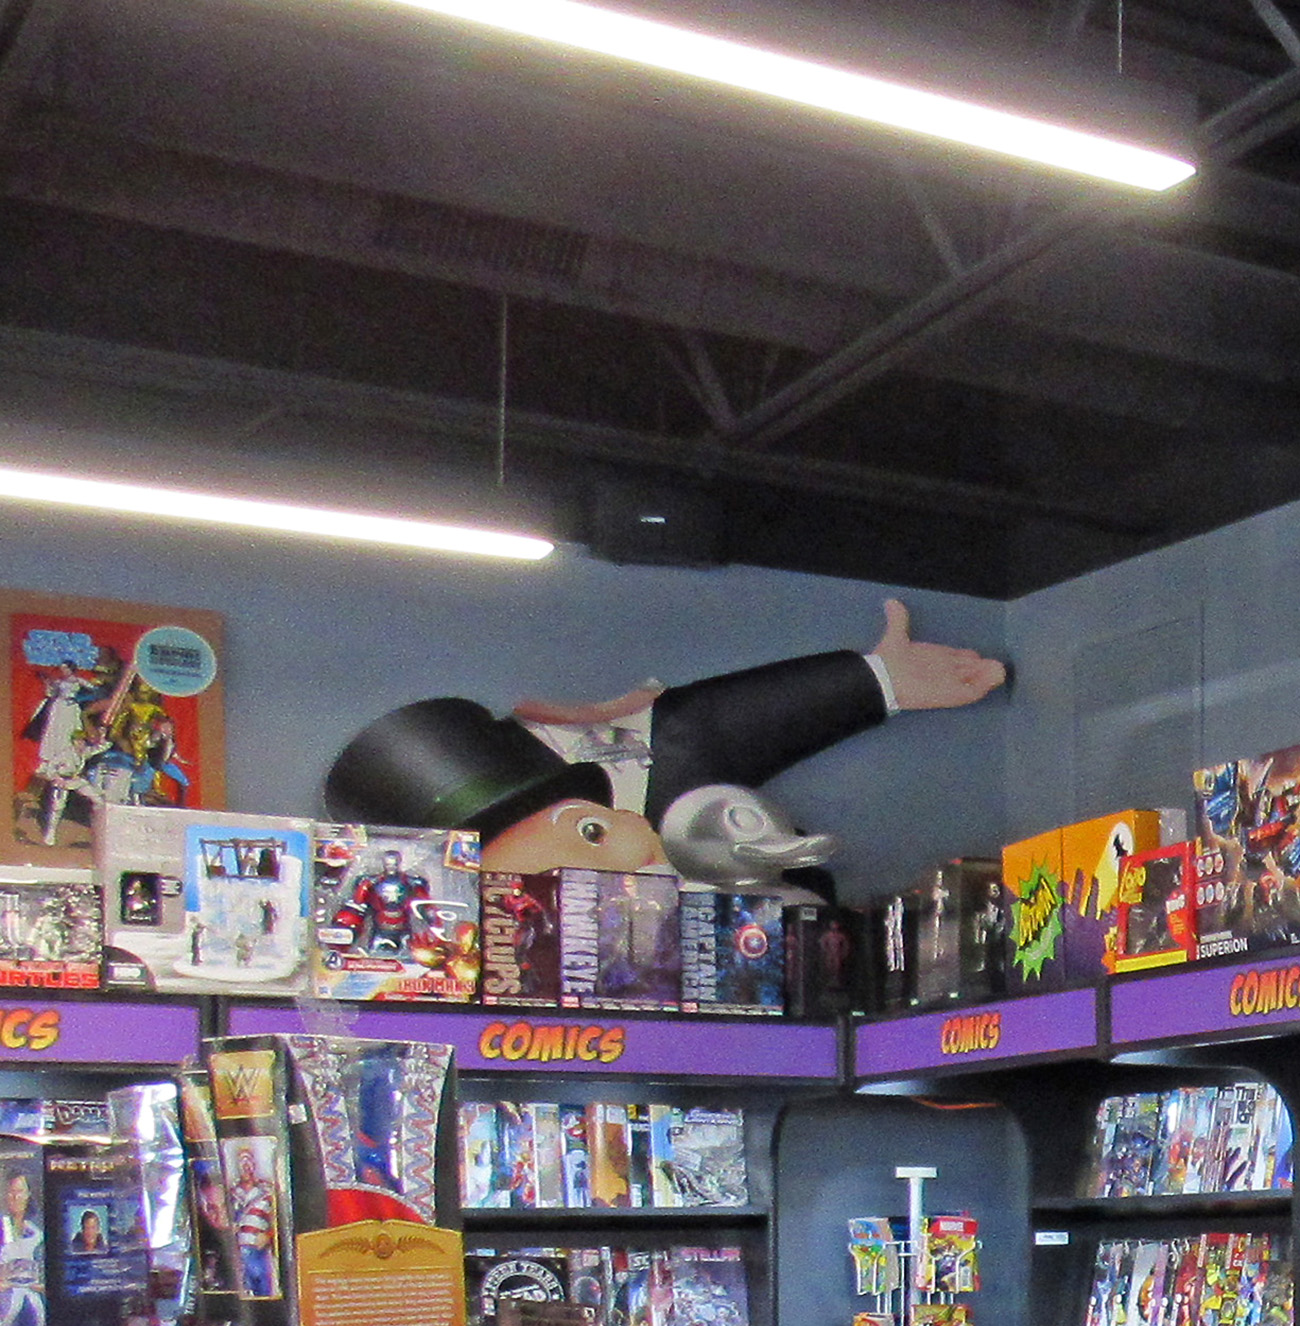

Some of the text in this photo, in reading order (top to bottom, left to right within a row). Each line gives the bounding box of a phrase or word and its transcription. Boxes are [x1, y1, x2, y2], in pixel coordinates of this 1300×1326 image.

[562, 881, 598, 993] HAWKEYE
[1200, 938, 1248, 958] SUPERION
[479, 1021, 626, 1063] COMICS
[942, 1012, 1001, 1054] COMICS
